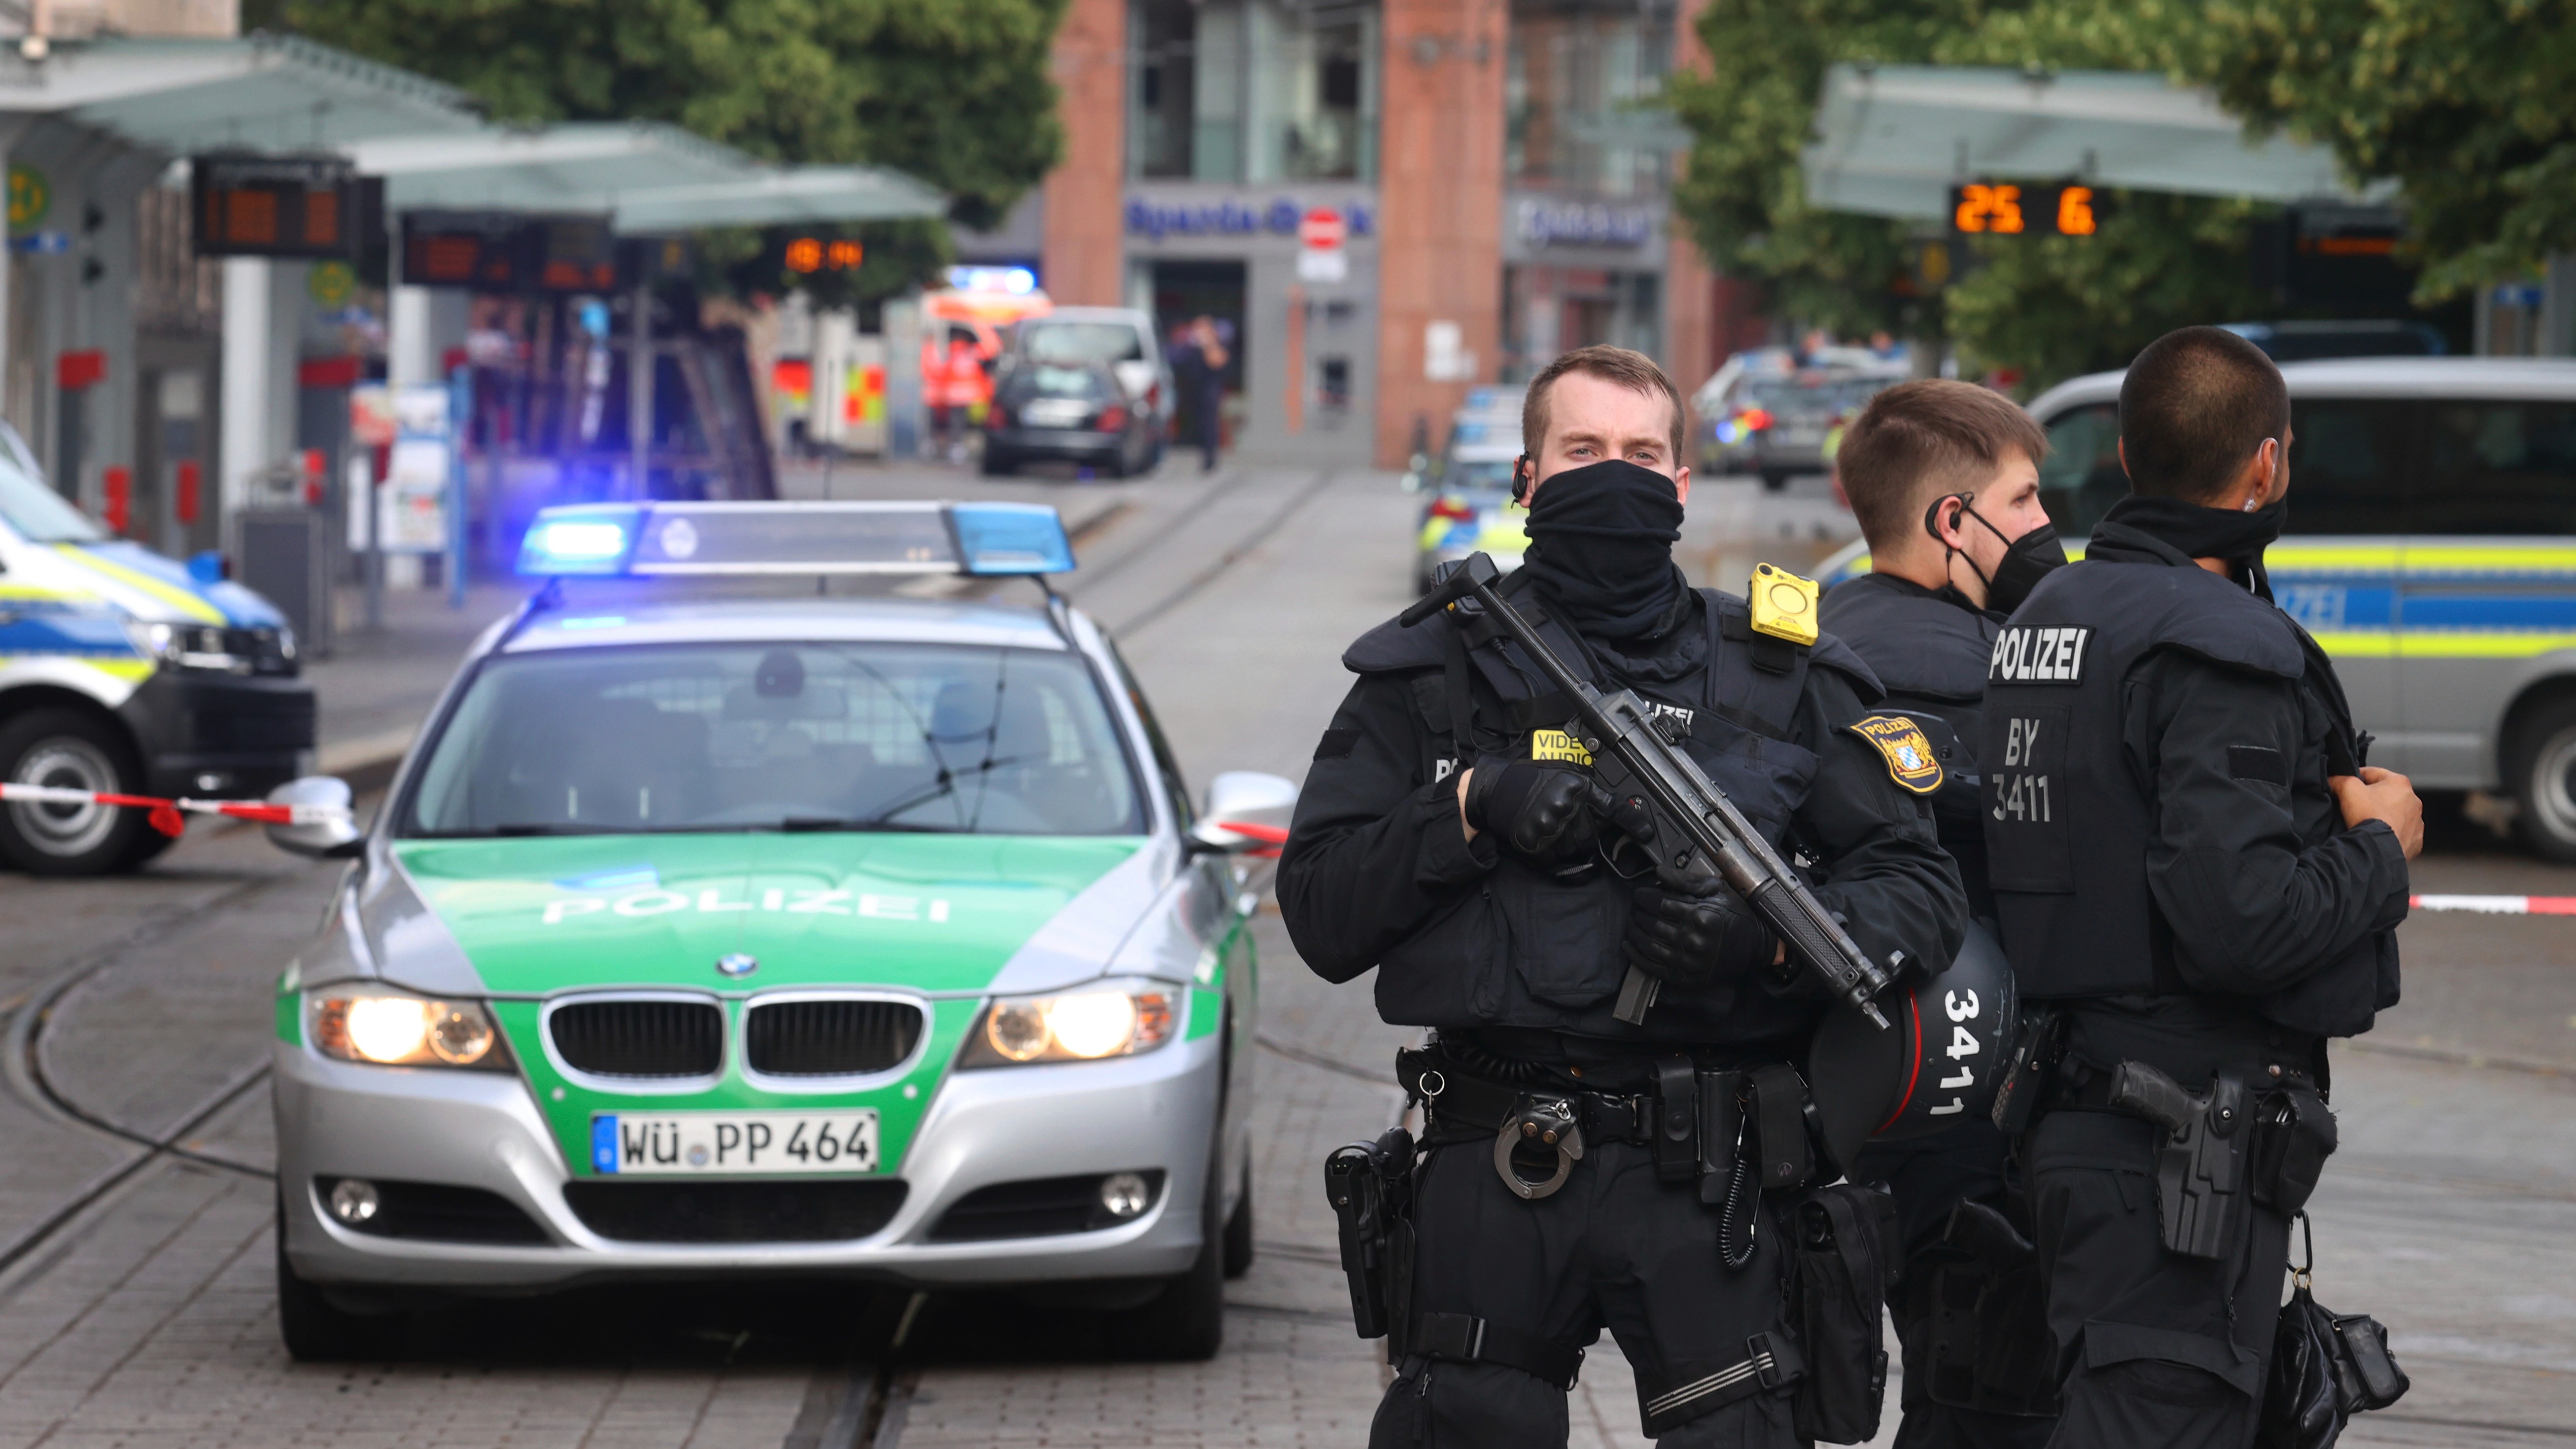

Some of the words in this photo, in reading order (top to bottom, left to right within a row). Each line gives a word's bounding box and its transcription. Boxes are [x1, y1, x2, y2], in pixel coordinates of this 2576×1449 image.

[1955, 183, 2025, 234] 25
[2056, 186, 2097, 236] 6
[1988, 628, 2088, 680] POLIZEI
[1865, 720, 1913, 735] POLIZEI
[2005, 718, 2040, 767] BY
[1993, 774, 2050, 822] 3411
[542, 887, 950, 924] POLIZEI
[1929, 989, 1980, 1115] 3411
[622, 1123, 679, 1164] WÜ
[716, 1123, 771, 1164] PP
[787, 1121, 870, 1162] 464
